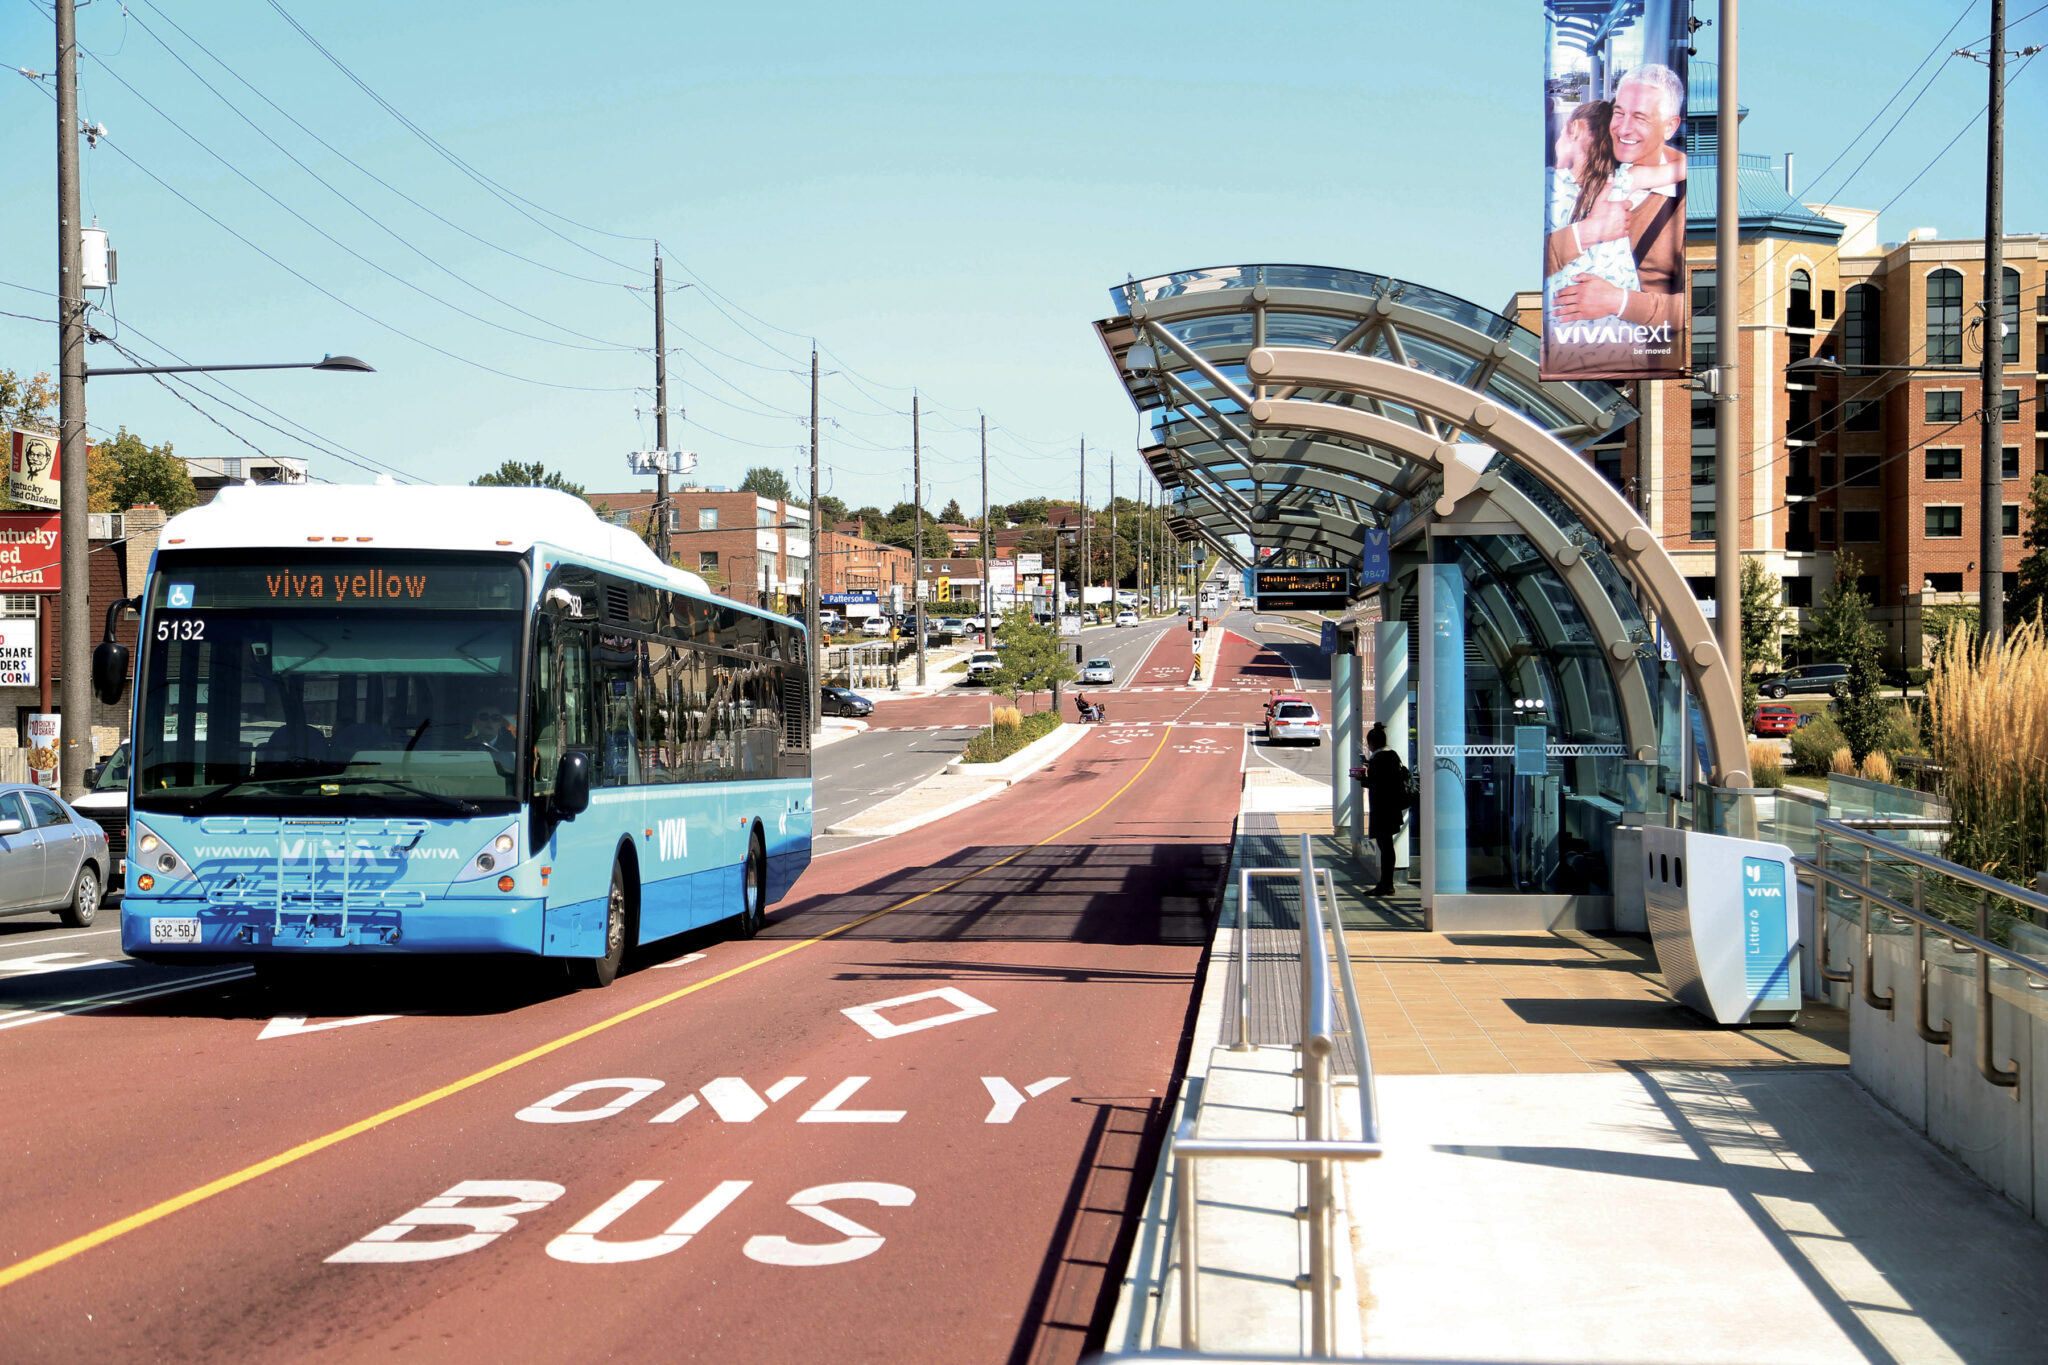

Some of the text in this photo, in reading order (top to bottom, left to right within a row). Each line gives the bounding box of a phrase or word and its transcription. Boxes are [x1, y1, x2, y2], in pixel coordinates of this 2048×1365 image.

[1633, 347, 1671, 355] be moved
[25, 492, 58, 505] Chicken
[1364, 569, 1386, 578] 9847
[266, 569, 426, 602] viva yellow
[829, 594, 864, 603] Patterson
[157, 620, 205, 641] 5132
[1, 672, 30, 683] CORN
[658, 817, 687, 862] VIVA
[1747, 887, 1782, 897] VIVA
[155, 924, 197, 938] 632 5BJ
[1749, 920, 1760, 954] Litter
[514, 1076, 1071, 1124] ONLY
[322, 1180, 916, 1268] BUS
